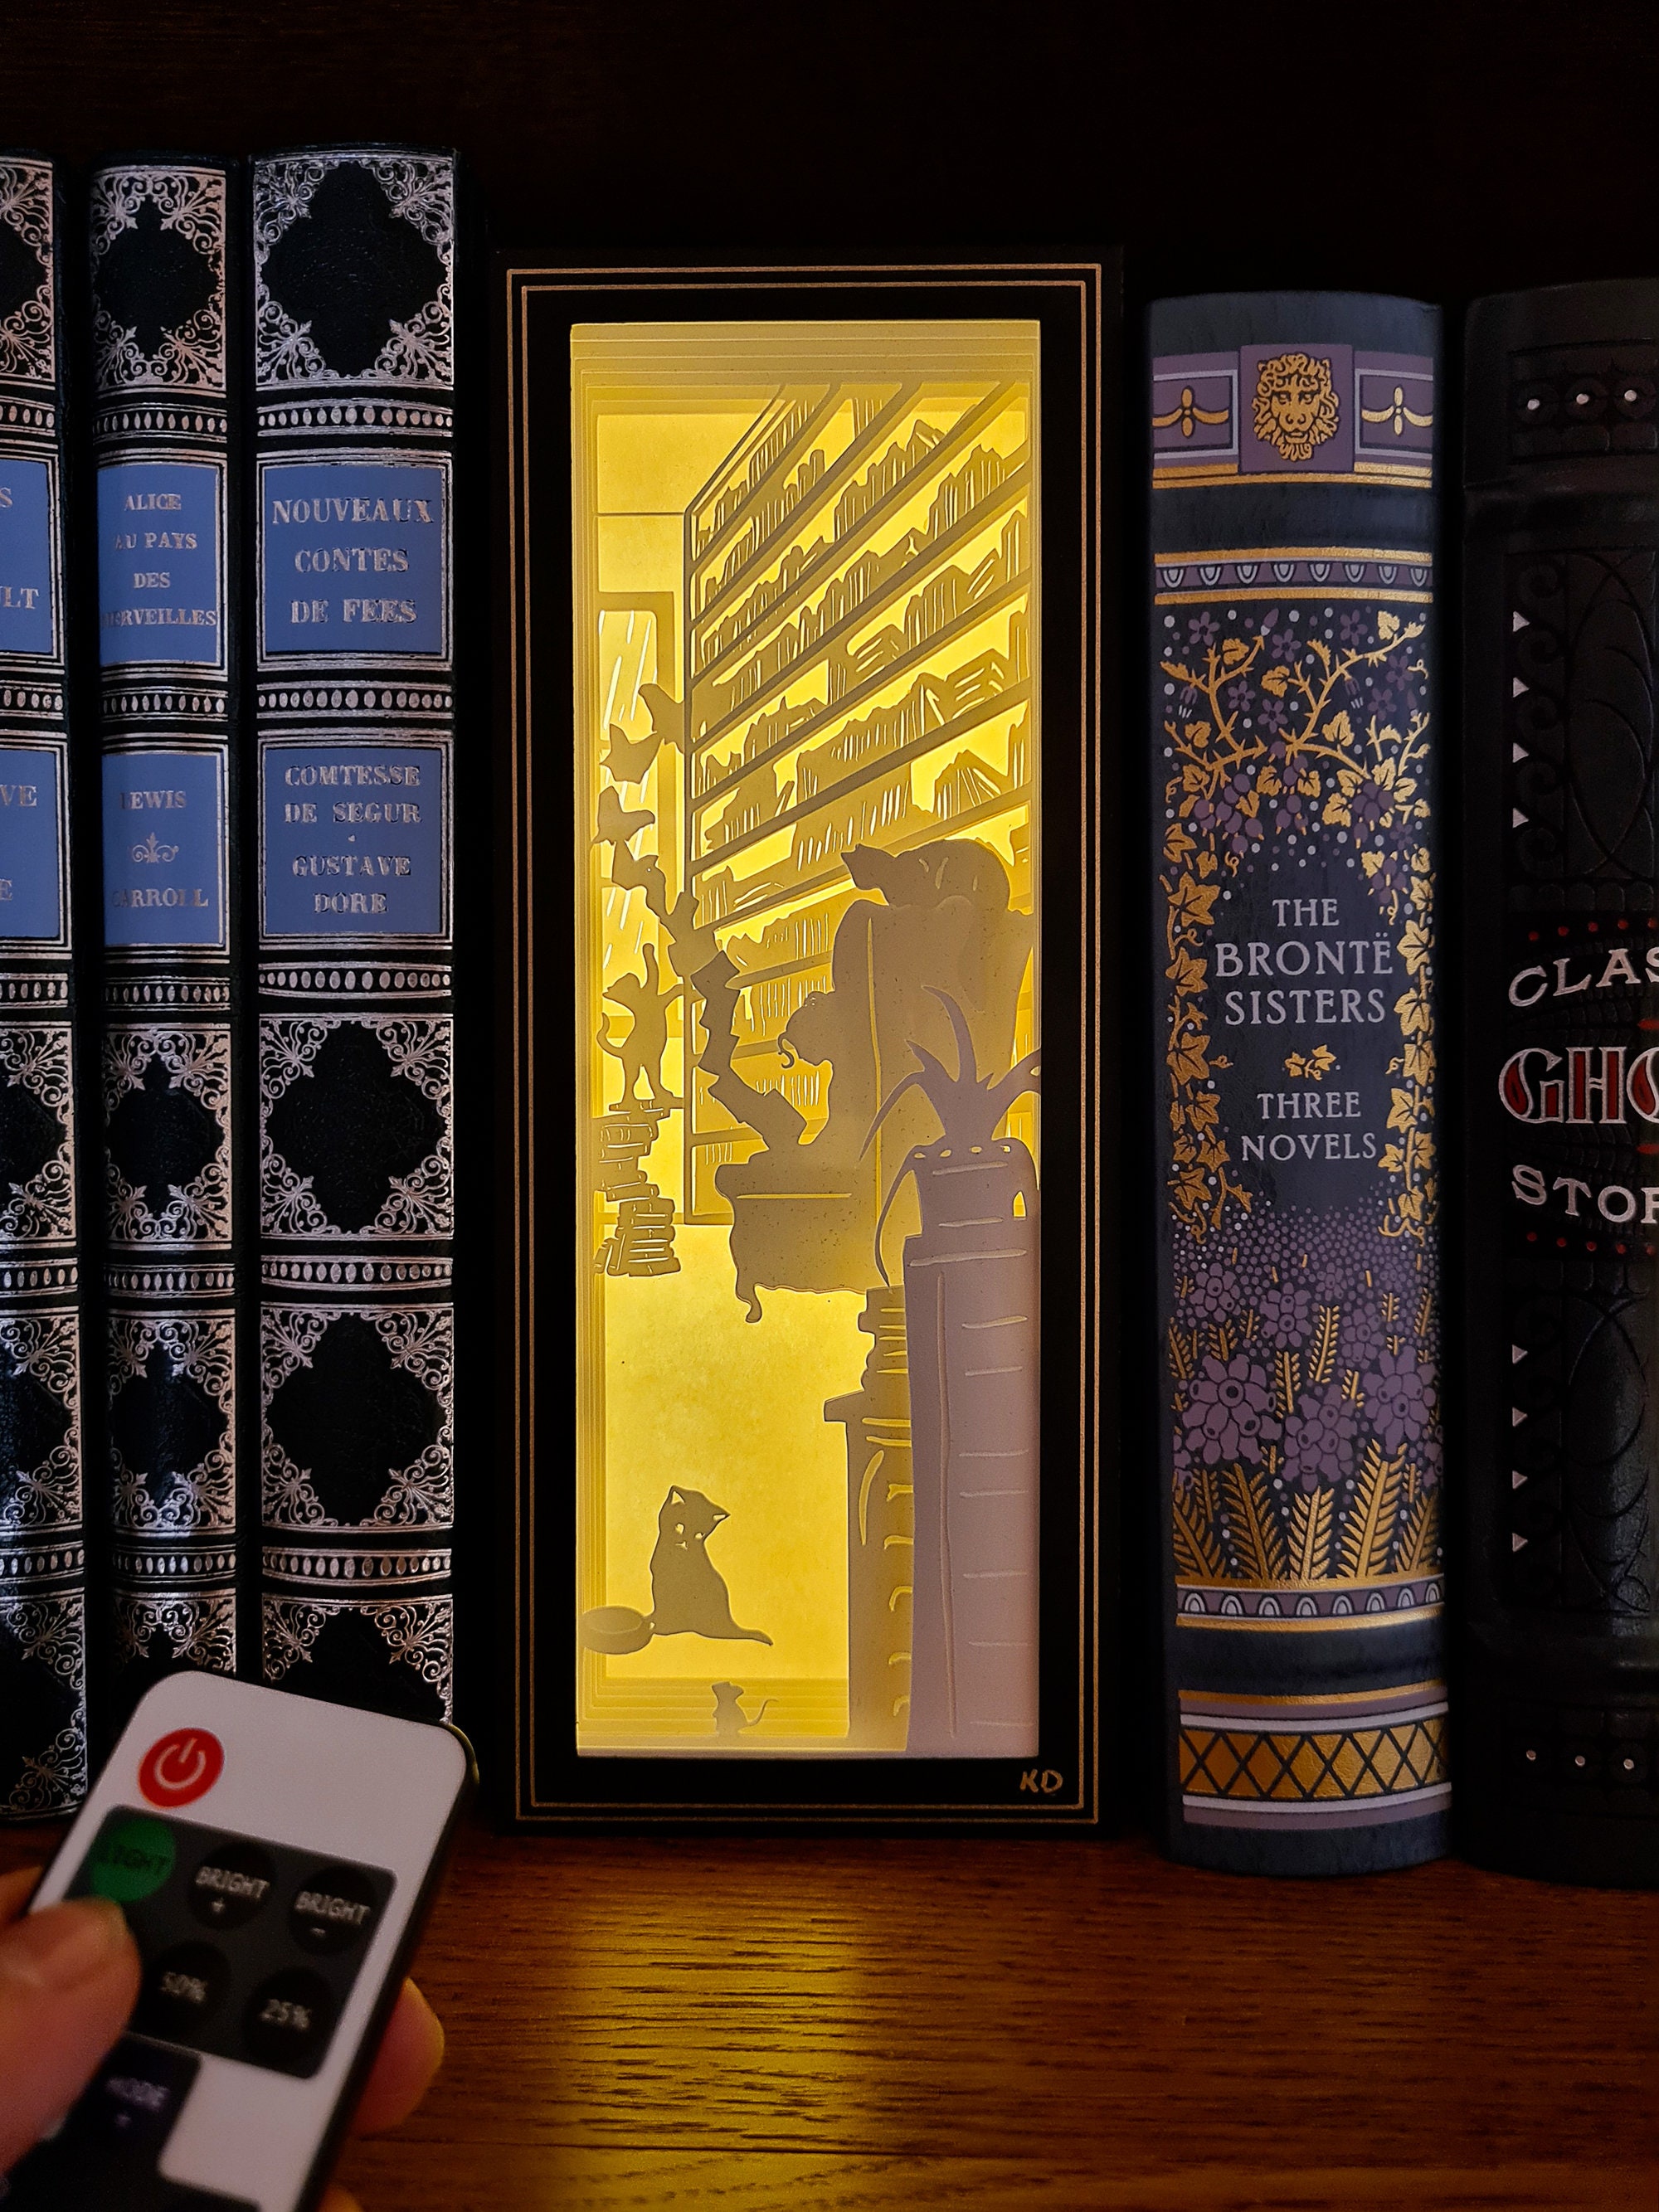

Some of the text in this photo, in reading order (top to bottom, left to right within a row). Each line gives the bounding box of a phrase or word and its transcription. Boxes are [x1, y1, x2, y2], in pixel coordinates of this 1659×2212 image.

[124, 493, 182, 511] ALICE
[272, 498, 435, 524] NOUVEAUX
[144, 532, 198, 550] PAYS
[294, 547, 410, 572] CONTES
[134, 572, 171, 589] DES
[0, 586, 39, 610] LT
[291, 599, 417, 624] DE FEES
[285, 765, 421, 786] COMTESSE
[285, 802, 422, 823] DE SEGUR
[292, 856, 411, 876] GUSTAVE
[314, 892, 387, 914] DORE
[1272, 898, 1340, 927] THE
[1215, 932, 1393, 977] BRONTË
[1225, 989, 1385, 1026] SISTERS
[1257, 1091, 1362, 1120] THREE
[1241, 1133, 1377, 1161] NOVELS
[1019, 1768, 1063, 1793] KD
[195, 1865, 271, 1902] BRIGHT
[294, 1890, 372, 1925] BRIGHT
[259, 1999, 313, 2032] 25%
